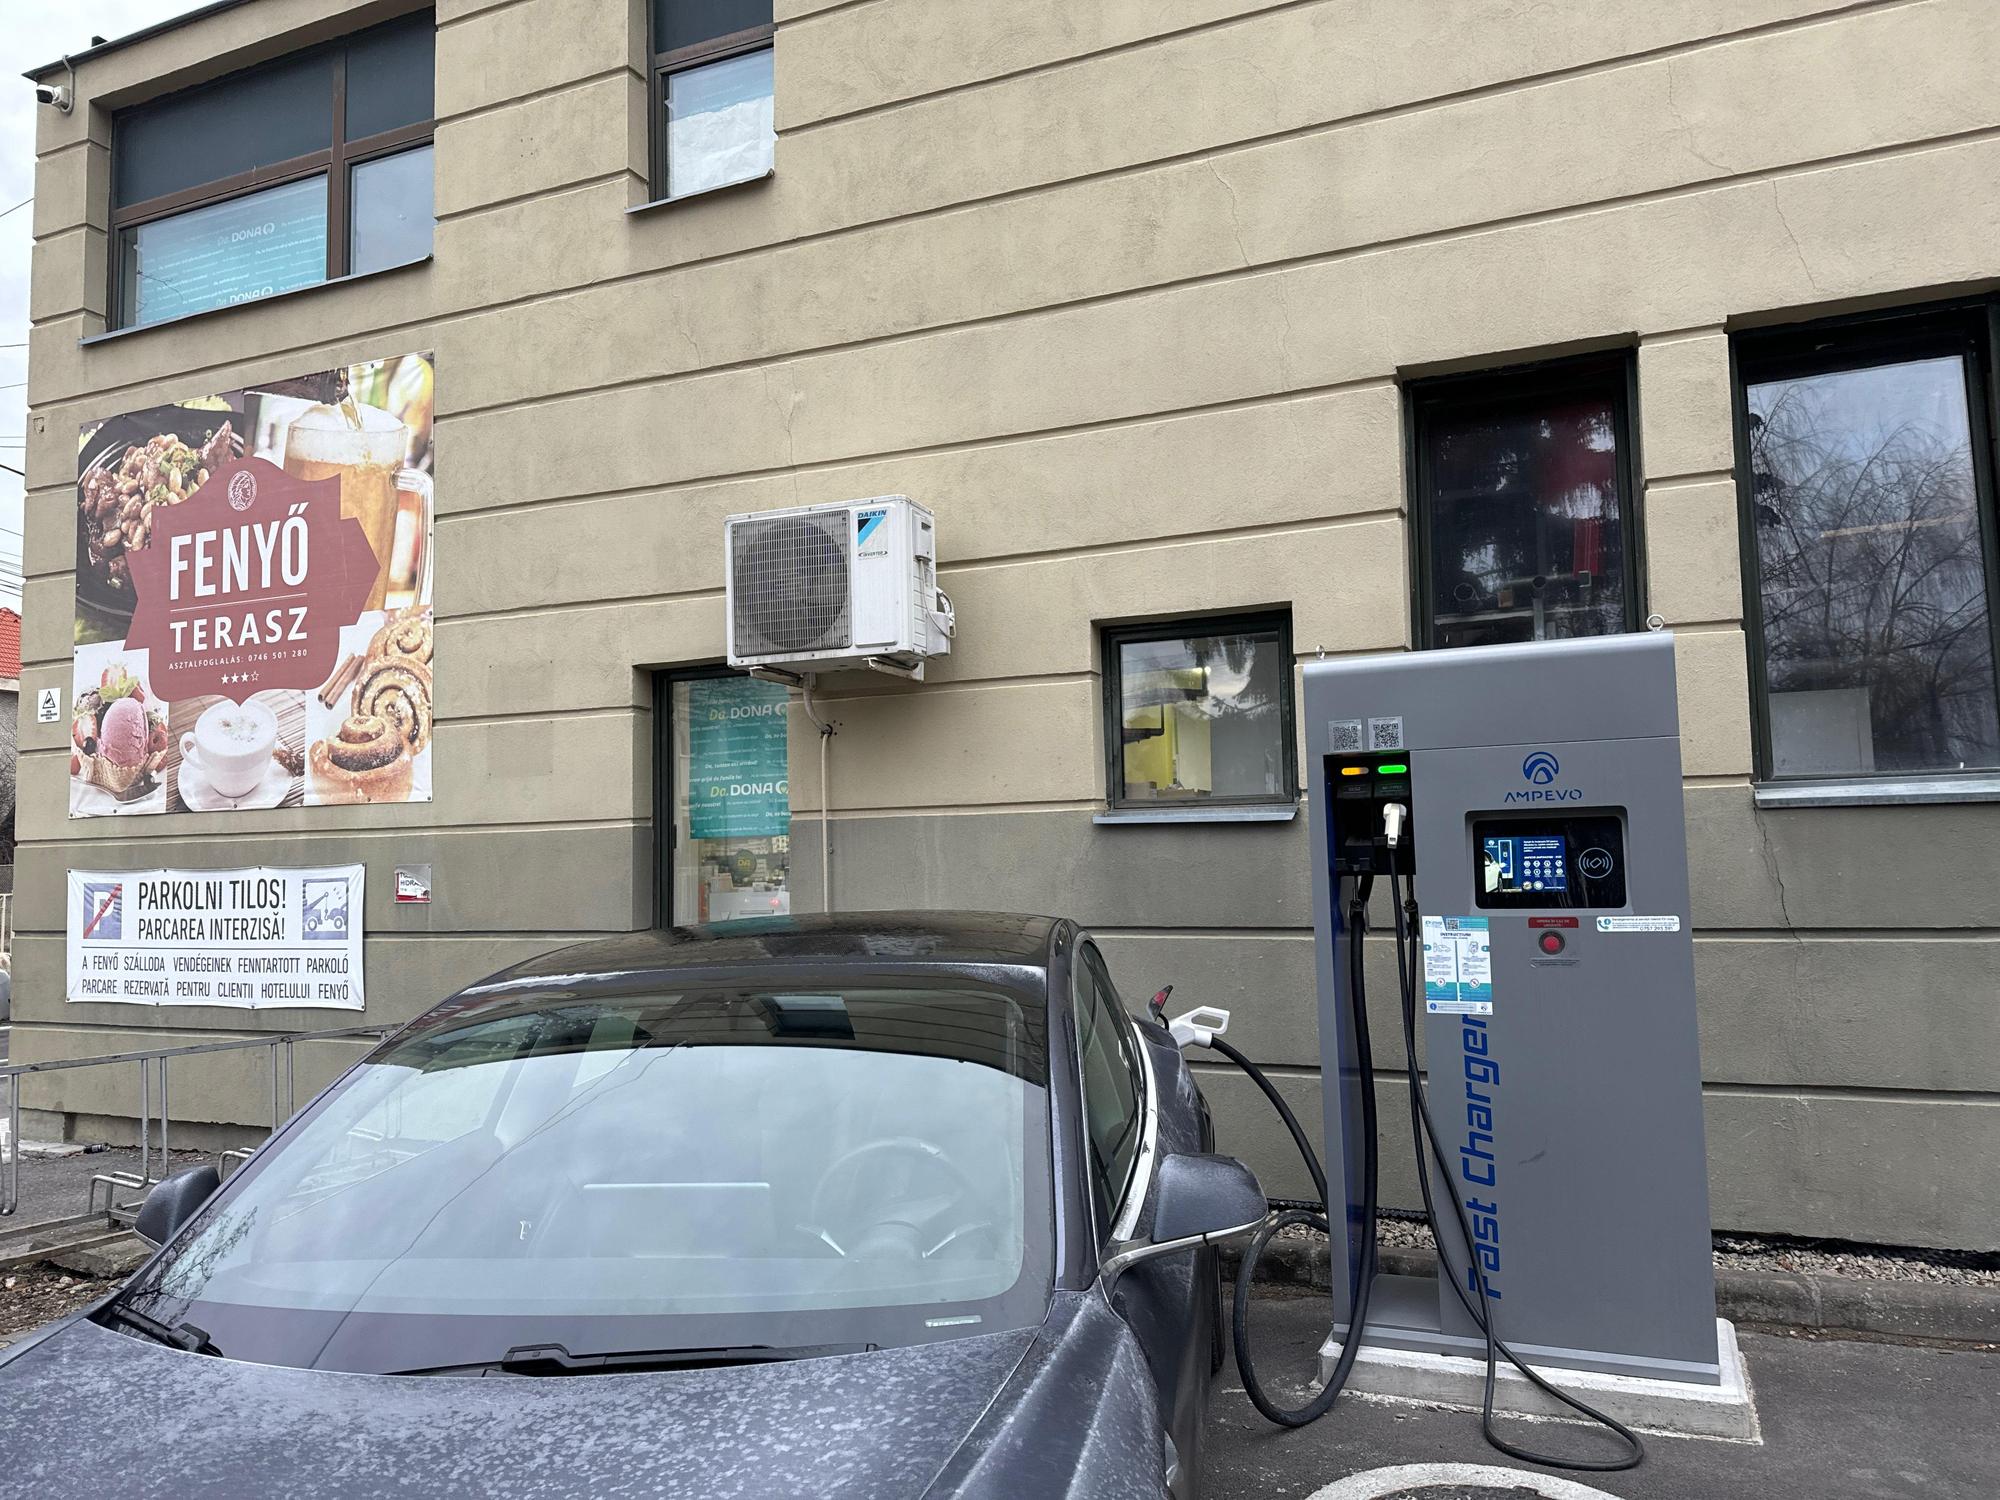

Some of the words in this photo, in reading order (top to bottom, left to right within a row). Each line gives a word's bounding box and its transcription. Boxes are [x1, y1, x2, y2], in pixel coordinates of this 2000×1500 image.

[857, 510, 887, 519] DAIKIN
[170, 501, 309, 601] FENYŐ
[169, 606, 308, 653] TERASZ
[168, 654, 244, 670] ASZTALFOGLALÁS:
[247, 652, 268, 662] 0746
[272, 651, 287, 660] 501
[292, 649, 307, 658] 280
[730, 704, 772, 720] DONA
[730, 782, 773, 797] DONA
[1504, 788, 1583, 803] AMPEVO
[138, 881, 222, 910] PARKOLNI
[229, 878, 286, 910] TILOS!
[138, 918, 205, 940] PARCAREA
[209, 911, 285, 940] INTERZISĂ!
[82, 955, 88, 971] A
[93, 952, 118, 971] FENYŐ
[124, 952, 165, 971] SZÁLLODA
[173, 953, 232, 972] VENDÉGEINEK
[238, 957, 300, 973] FENNTARTOTT
[307, 954, 348, 974] PARKOLÓ
[82, 979, 117, 994] PARCARE
[124, 978, 169, 996] REZERVATĂ
[176, 981, 210, 997] PENTRU
[217, 982, 253, 999] CLIENTII
[261, 983, 310, 999] HOTELULUI
[318, 980, 348, 1000] FENYŐ
[1460, 1014, 1500, 1187] Charger
[1466, 1197, 1501, 1300] Fast
